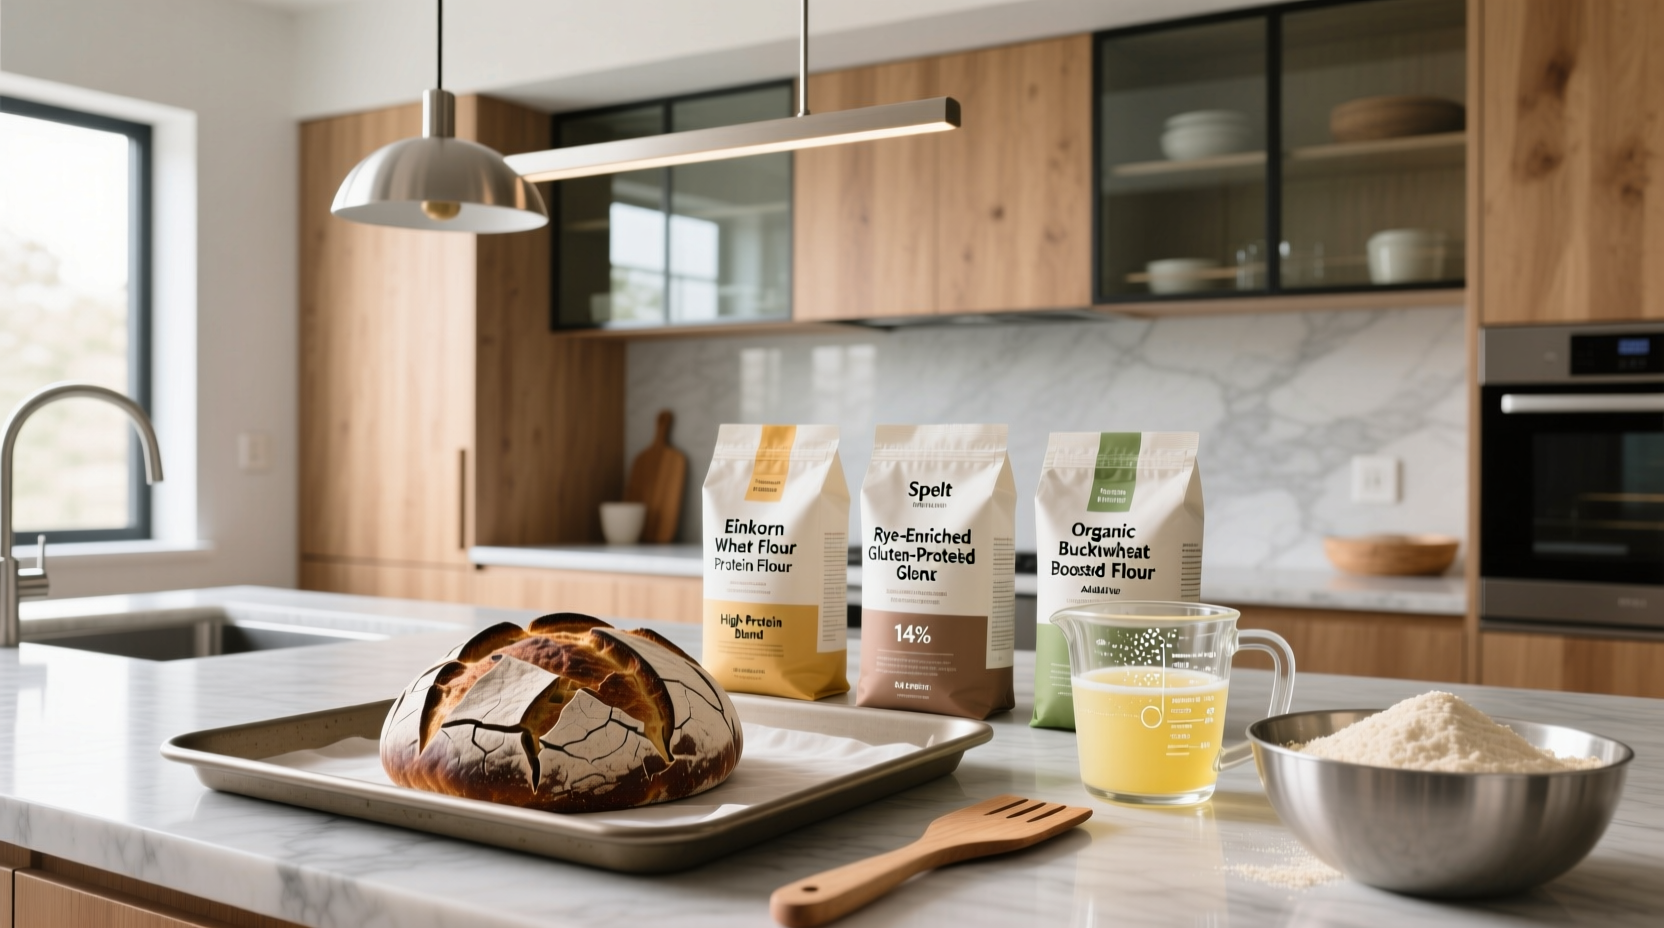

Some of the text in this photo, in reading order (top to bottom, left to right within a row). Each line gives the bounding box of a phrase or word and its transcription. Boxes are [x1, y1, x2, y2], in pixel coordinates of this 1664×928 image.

[908, 481, 953, 501] Spelt
[724, 518, 785, 536] Einkorn
[874, 526, 971, 545] Rye-Enriched
[1072, 522, 1136, 542] Organic
[758, 539, 797, 555] Flour
[714, 557, 793, 573] Protein Flour
[1111, 563, 1156, 581] Flour
[894, 623, 931, 644] 14%
